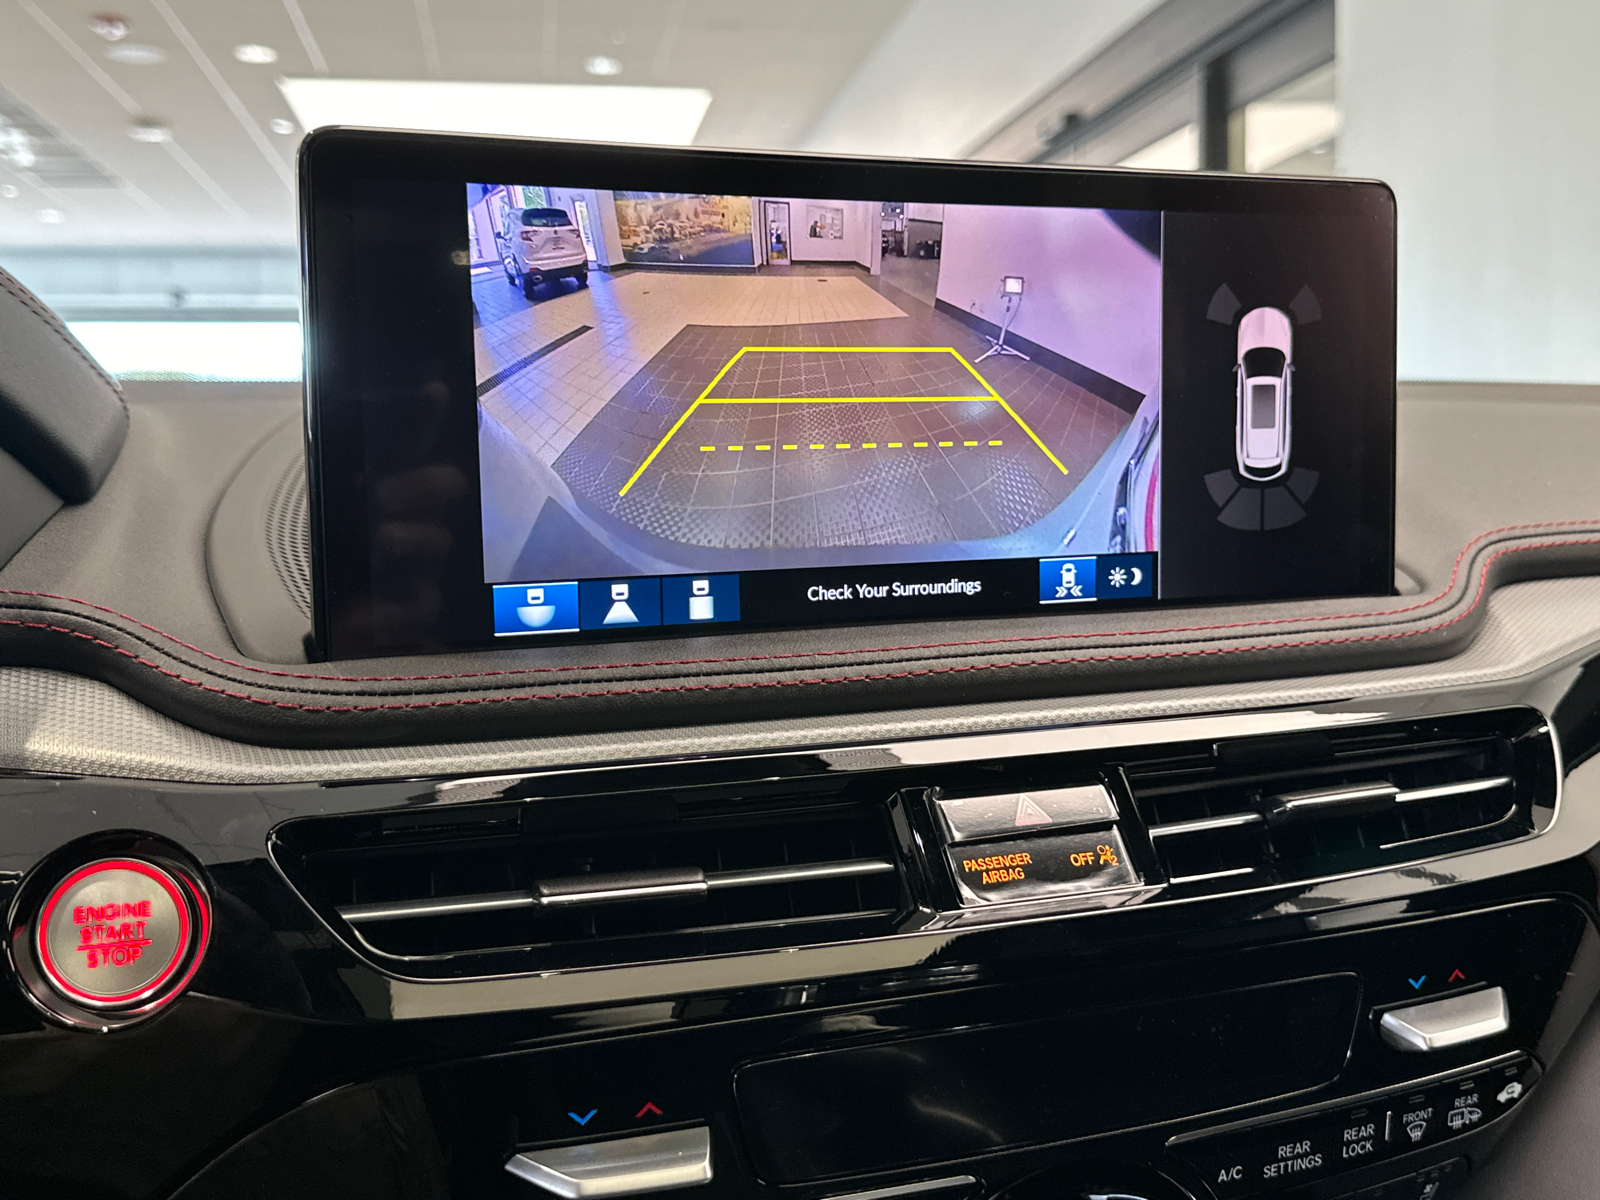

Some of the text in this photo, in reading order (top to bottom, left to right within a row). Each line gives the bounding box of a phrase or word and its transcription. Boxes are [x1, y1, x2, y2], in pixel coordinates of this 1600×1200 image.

[807, 578, 982, 601] Check Your Surroundings
[963, 853, 1032, 872] PASSENGER
[1069, 852, 1095, 867] OFF
[982, 867, 1025, 885] AIRBAG
[73, 900, 152, 925] ENGINE
[80, 921, 148, 944] START
[86, 946, 144, 969] STOP
[1454, 1093, 1479, 1108] REAR
[1402, 1107, 1434, 1124] FRONT
[1343, 1123, 1375, 1142] REAR
[1278, 1140, 1311, 1159] REAR
[1342, 1140, 1374, 1158] LOCK
[1217, 1165, 1243, 1183] A/C
[1263, 1153, 1323, 1178] SETTINGS
